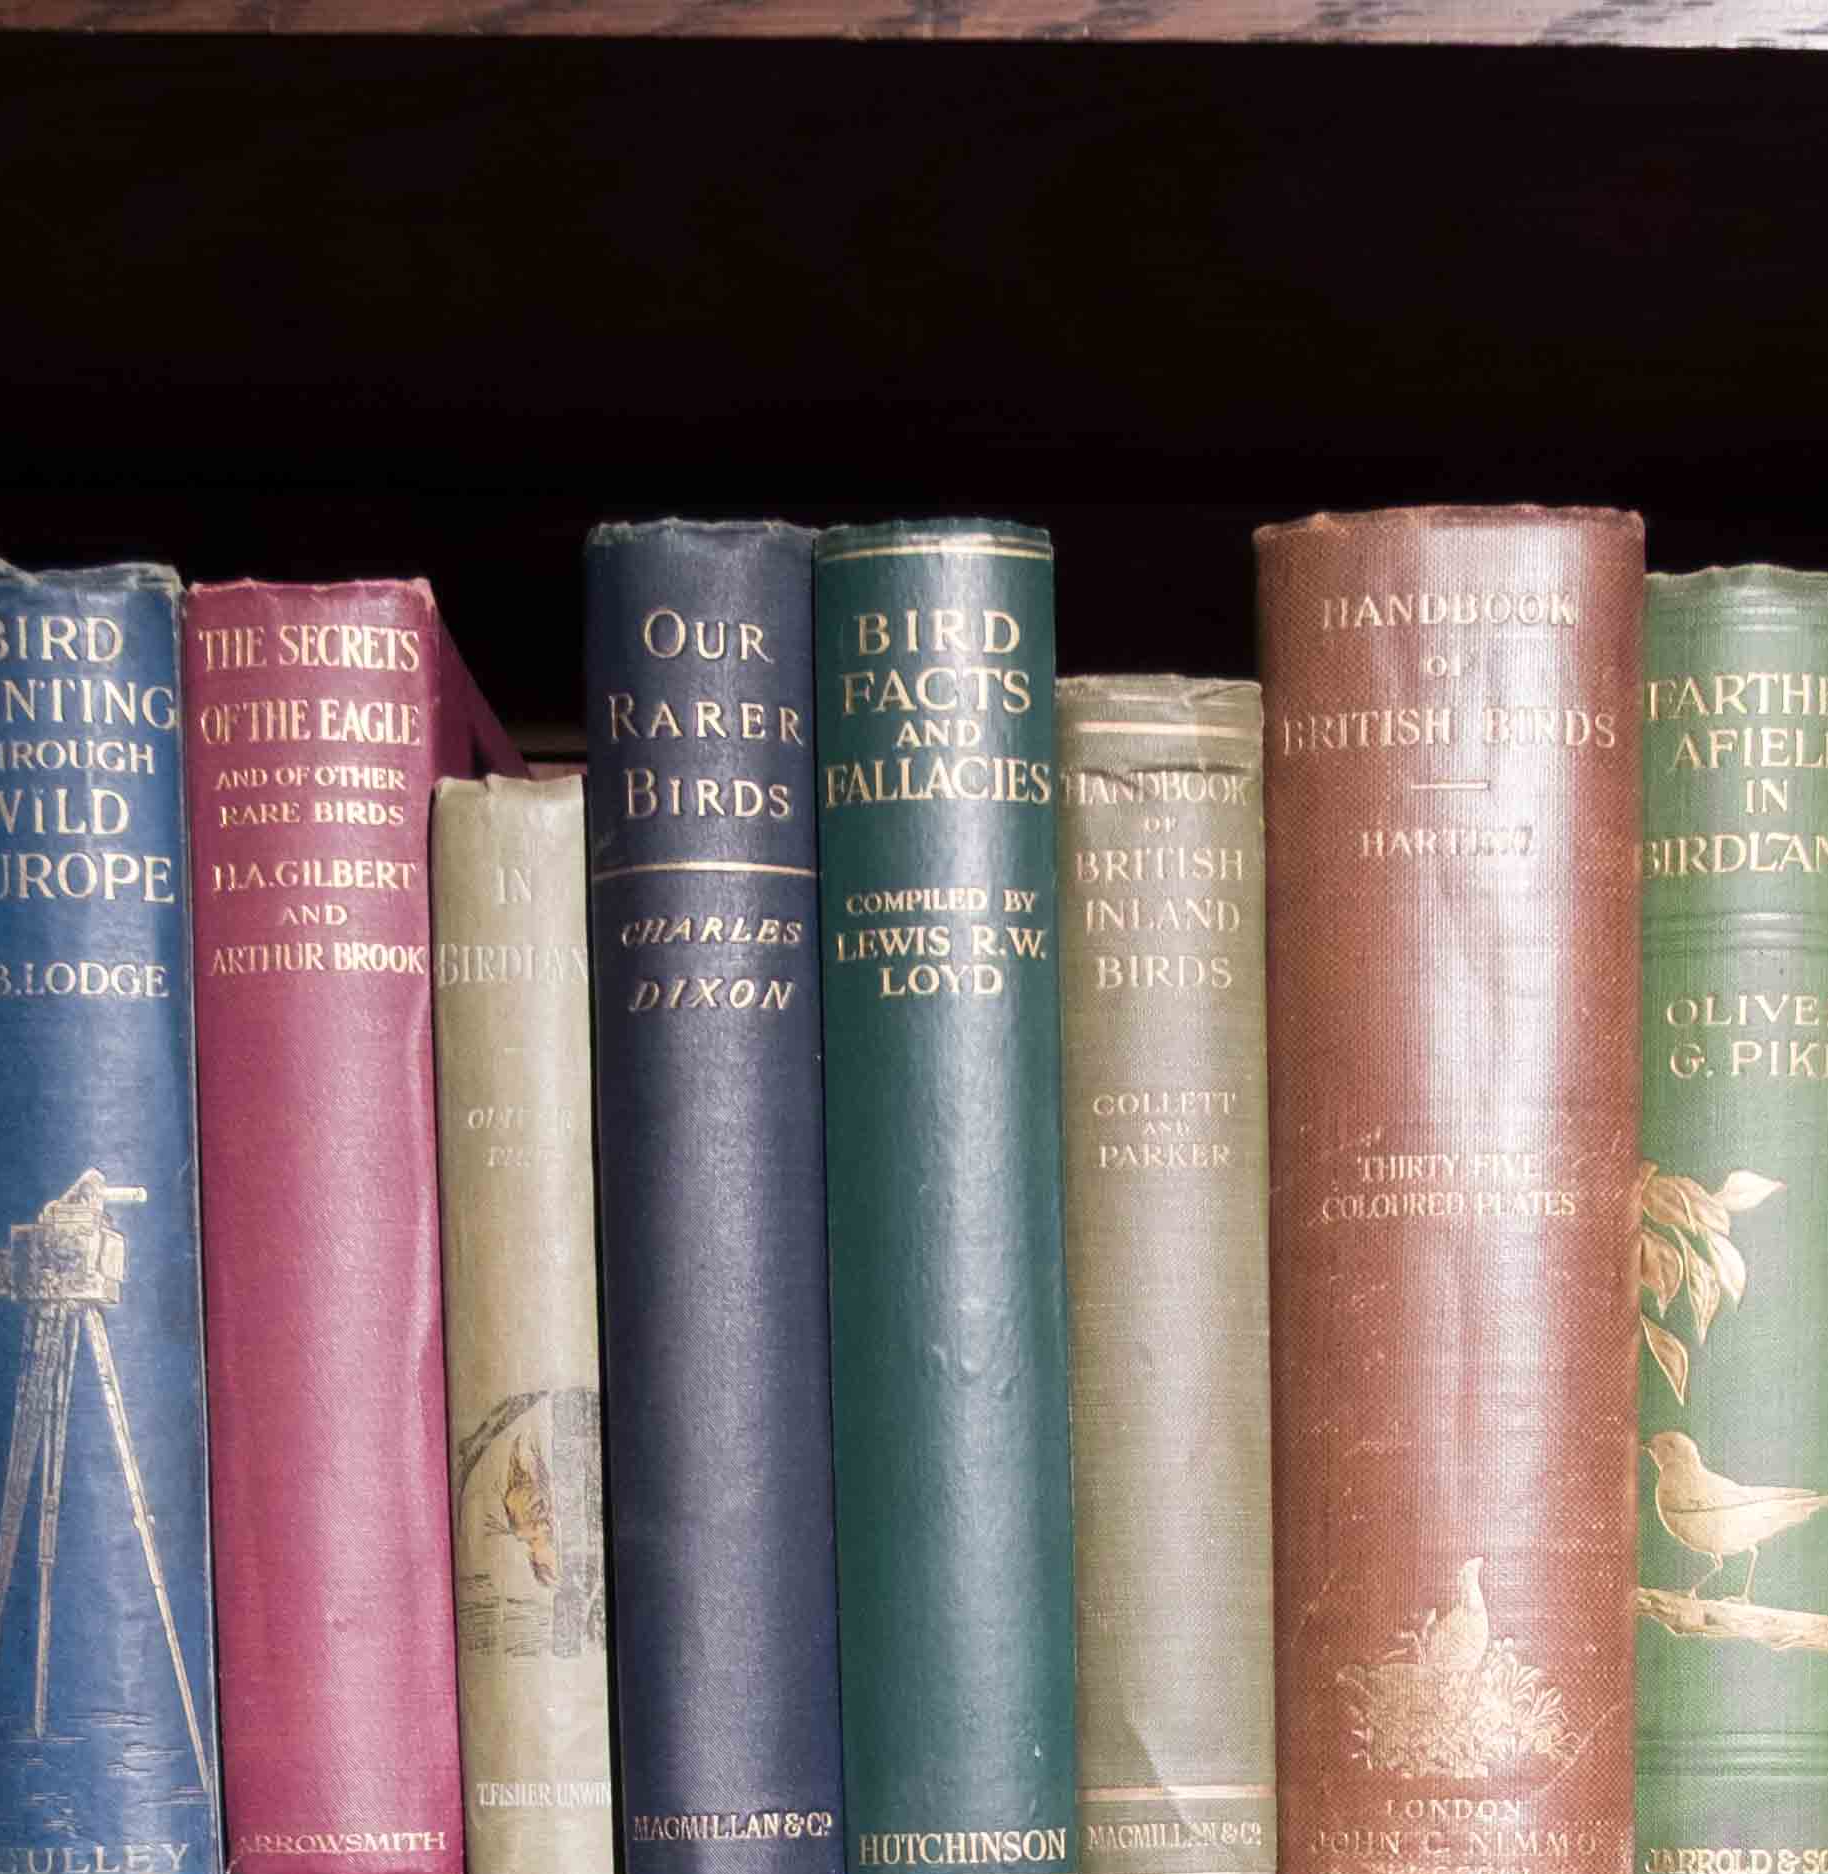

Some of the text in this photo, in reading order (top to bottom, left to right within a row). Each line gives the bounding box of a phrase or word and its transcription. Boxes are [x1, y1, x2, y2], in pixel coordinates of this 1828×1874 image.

[198, 625, 420, 672] THE SECRETS
[644, 610, 772, 664] OUR
[858, 610, 1019, 656] BIRD
[842, 667, 1030, 715] FACTS
[321, 699, 420, 746] EAGLE
[609, 694, 803, 746] RARER
[896, 720, 980, 747] AND
[217, 767, 406, 790] AND OF OTHER
[625, 768, 791, 819] BIRDS
[826, 757, 1052, 809] FALLACIES
[1745, 779, 1788, 816] IN
[314, 803, 404, 826] BIRDS
[1077, 848, 1243, 881] BRITISH
[282, 905, 347, 925] AND
[846, 888, 1036, 914] COMPILED BY
[1086, 898, 1239, 934] INLAND
[622, 917, 802, 946] CHARLES
[837, 926, 949, 961] LEWIS
[212, 944, 426, 975] ARTHUR BROOK
[1098, 956, 1232, 989] BIRDS
[630, 979, 795, 1012] DIXON
[880, 965, 1003, 998] LOYD
[1099, 1144, 1229, 1168] PARKER
[237, 1831, 446, 1854] ARROWSMITH
[859, 1828, 1067, 1866] HUTCHINSON
